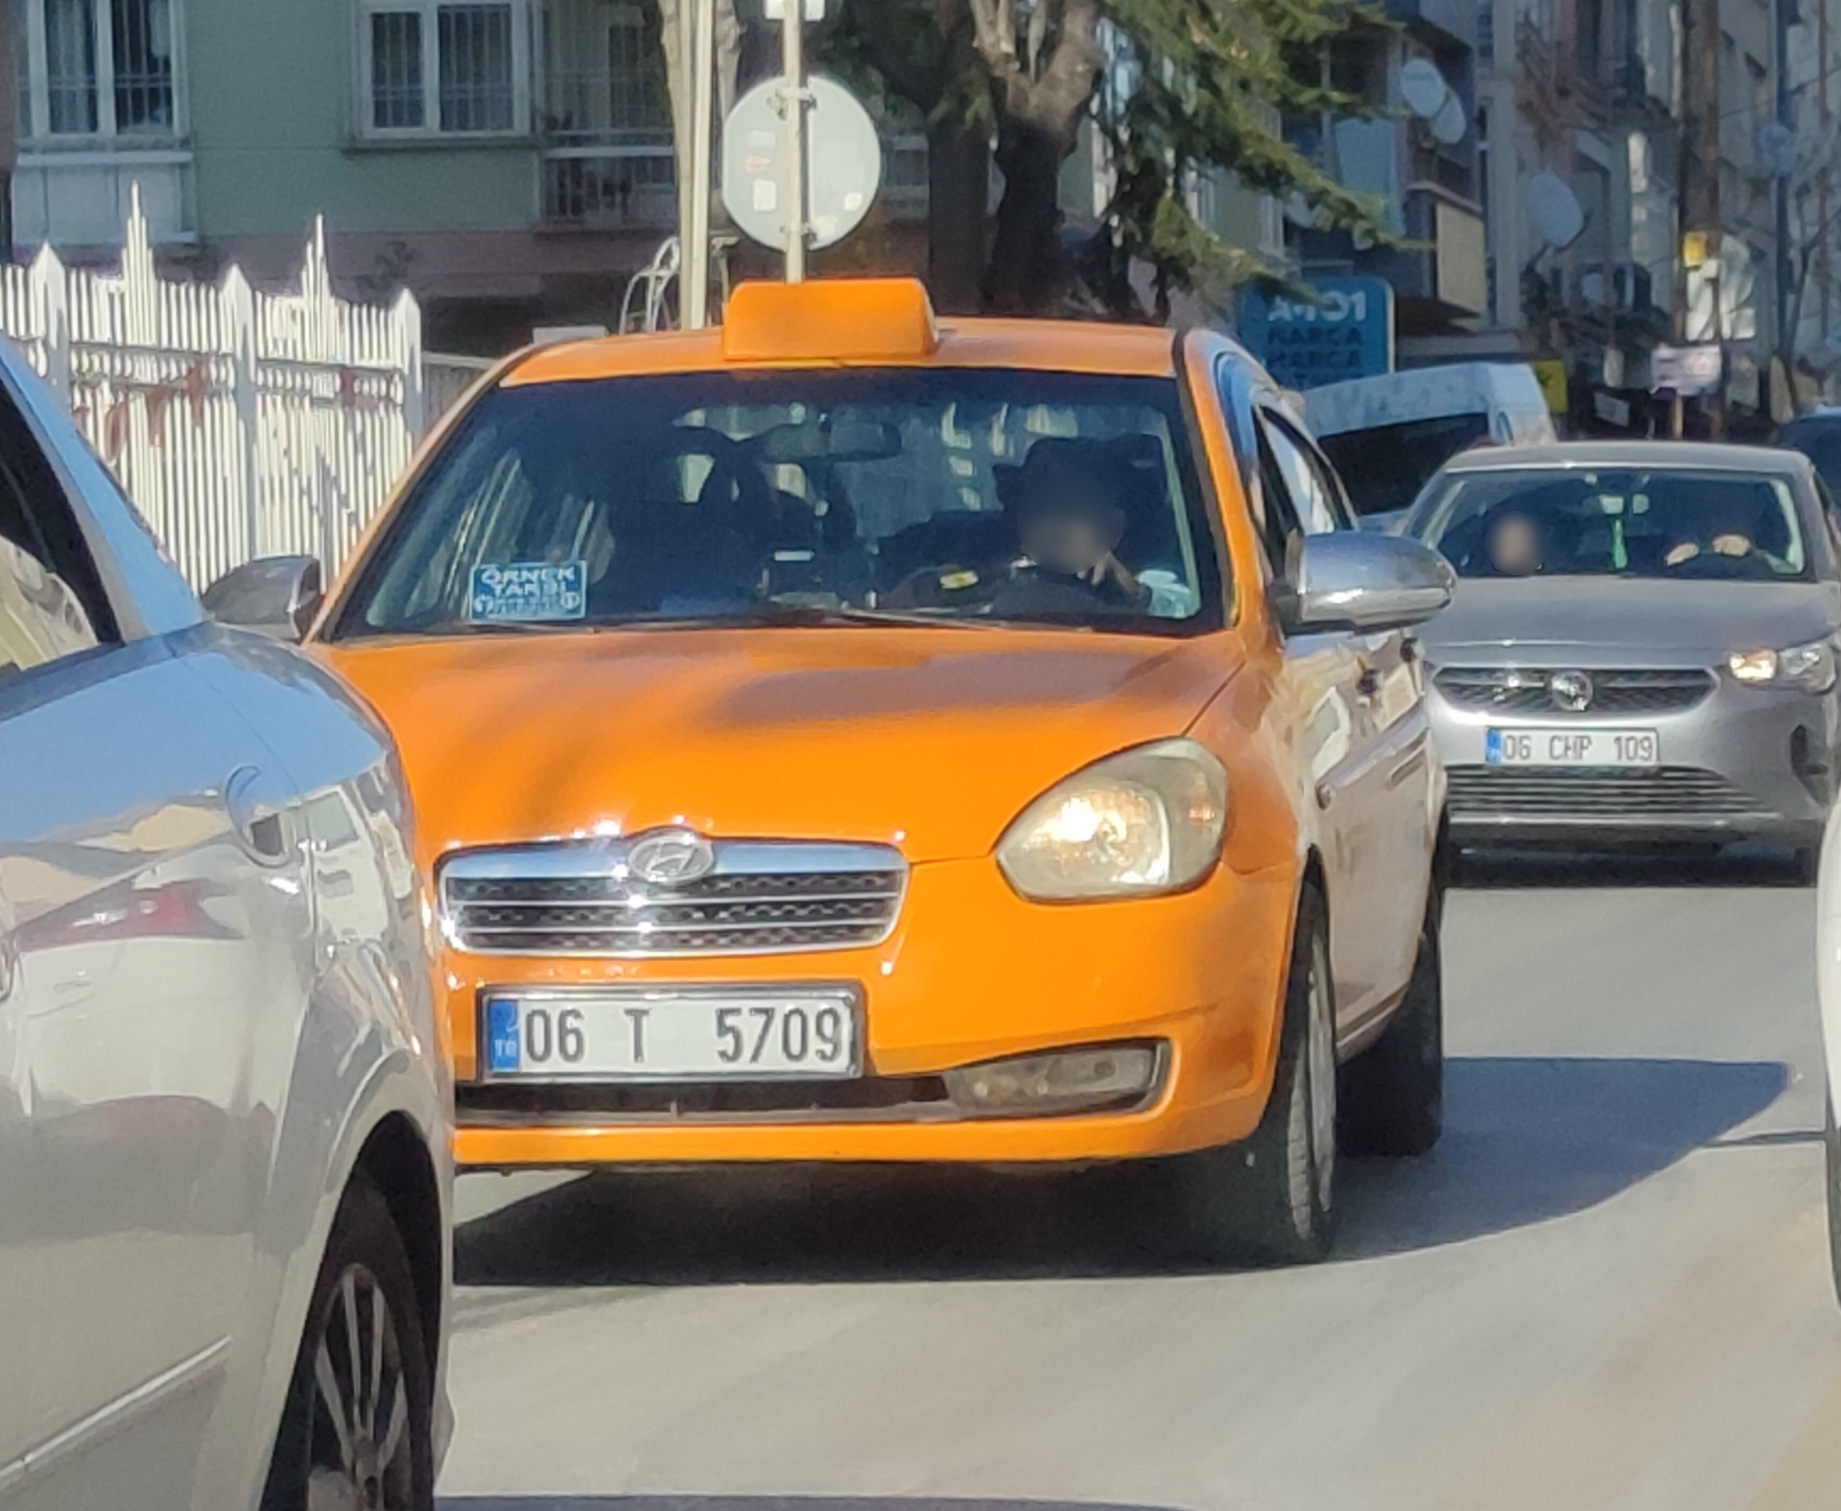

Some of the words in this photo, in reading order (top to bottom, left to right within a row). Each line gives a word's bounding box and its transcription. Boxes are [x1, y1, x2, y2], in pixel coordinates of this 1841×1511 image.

[1505, 735, 1531, 760] 06
[1549, 735, 1592, 760] CHP
[1614, 736, 1653, 761] 109
[525, 1008, 585, 1063] 06
[624, 1008, 651, 1063] T
[715, 1007, 842, 1063] 5709
